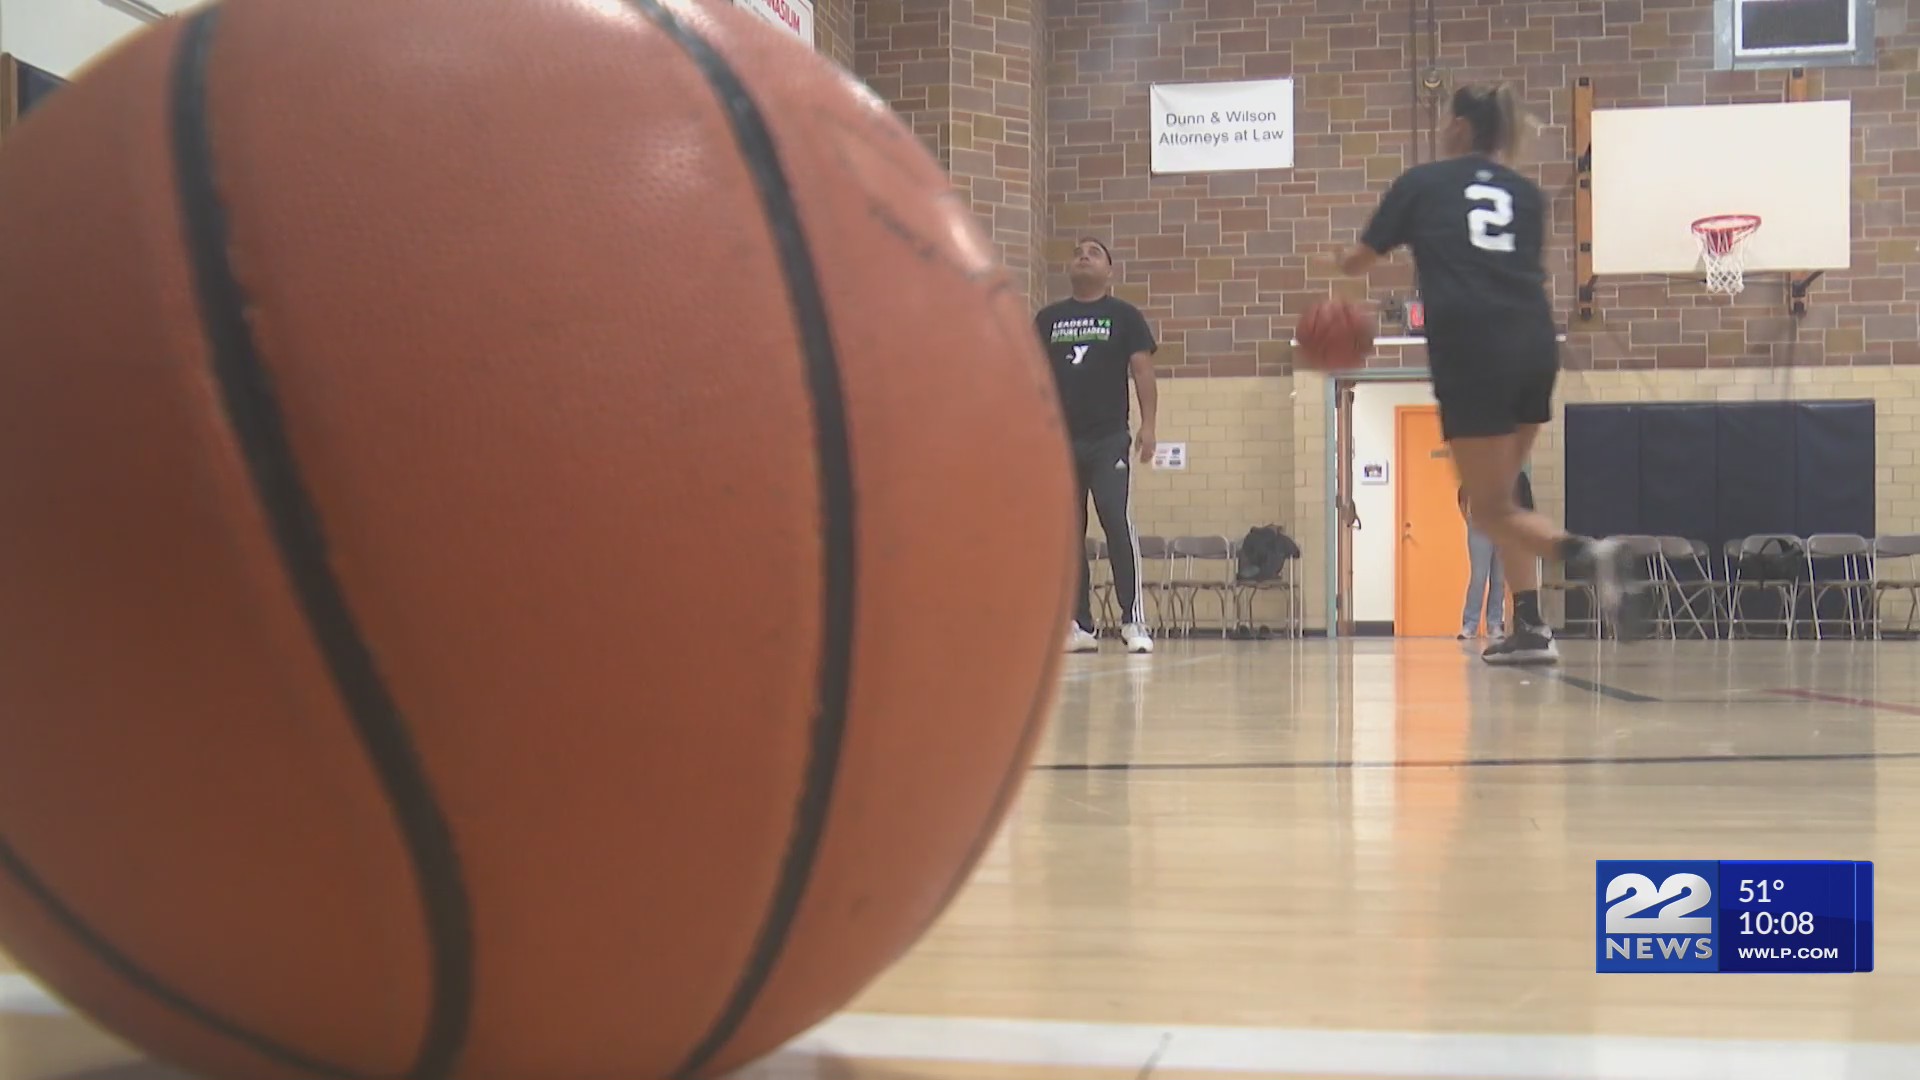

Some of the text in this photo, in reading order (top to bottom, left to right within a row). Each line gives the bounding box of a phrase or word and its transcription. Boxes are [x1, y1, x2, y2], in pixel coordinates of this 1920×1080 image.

[1166, 110, 1276, 127] Dunn & Wilson
[1158, 128, 1284, 147] Attorneys at Law
[1464, 184, 1516, 252] 2
[1053, 318, 1094, 329] LEADERS
